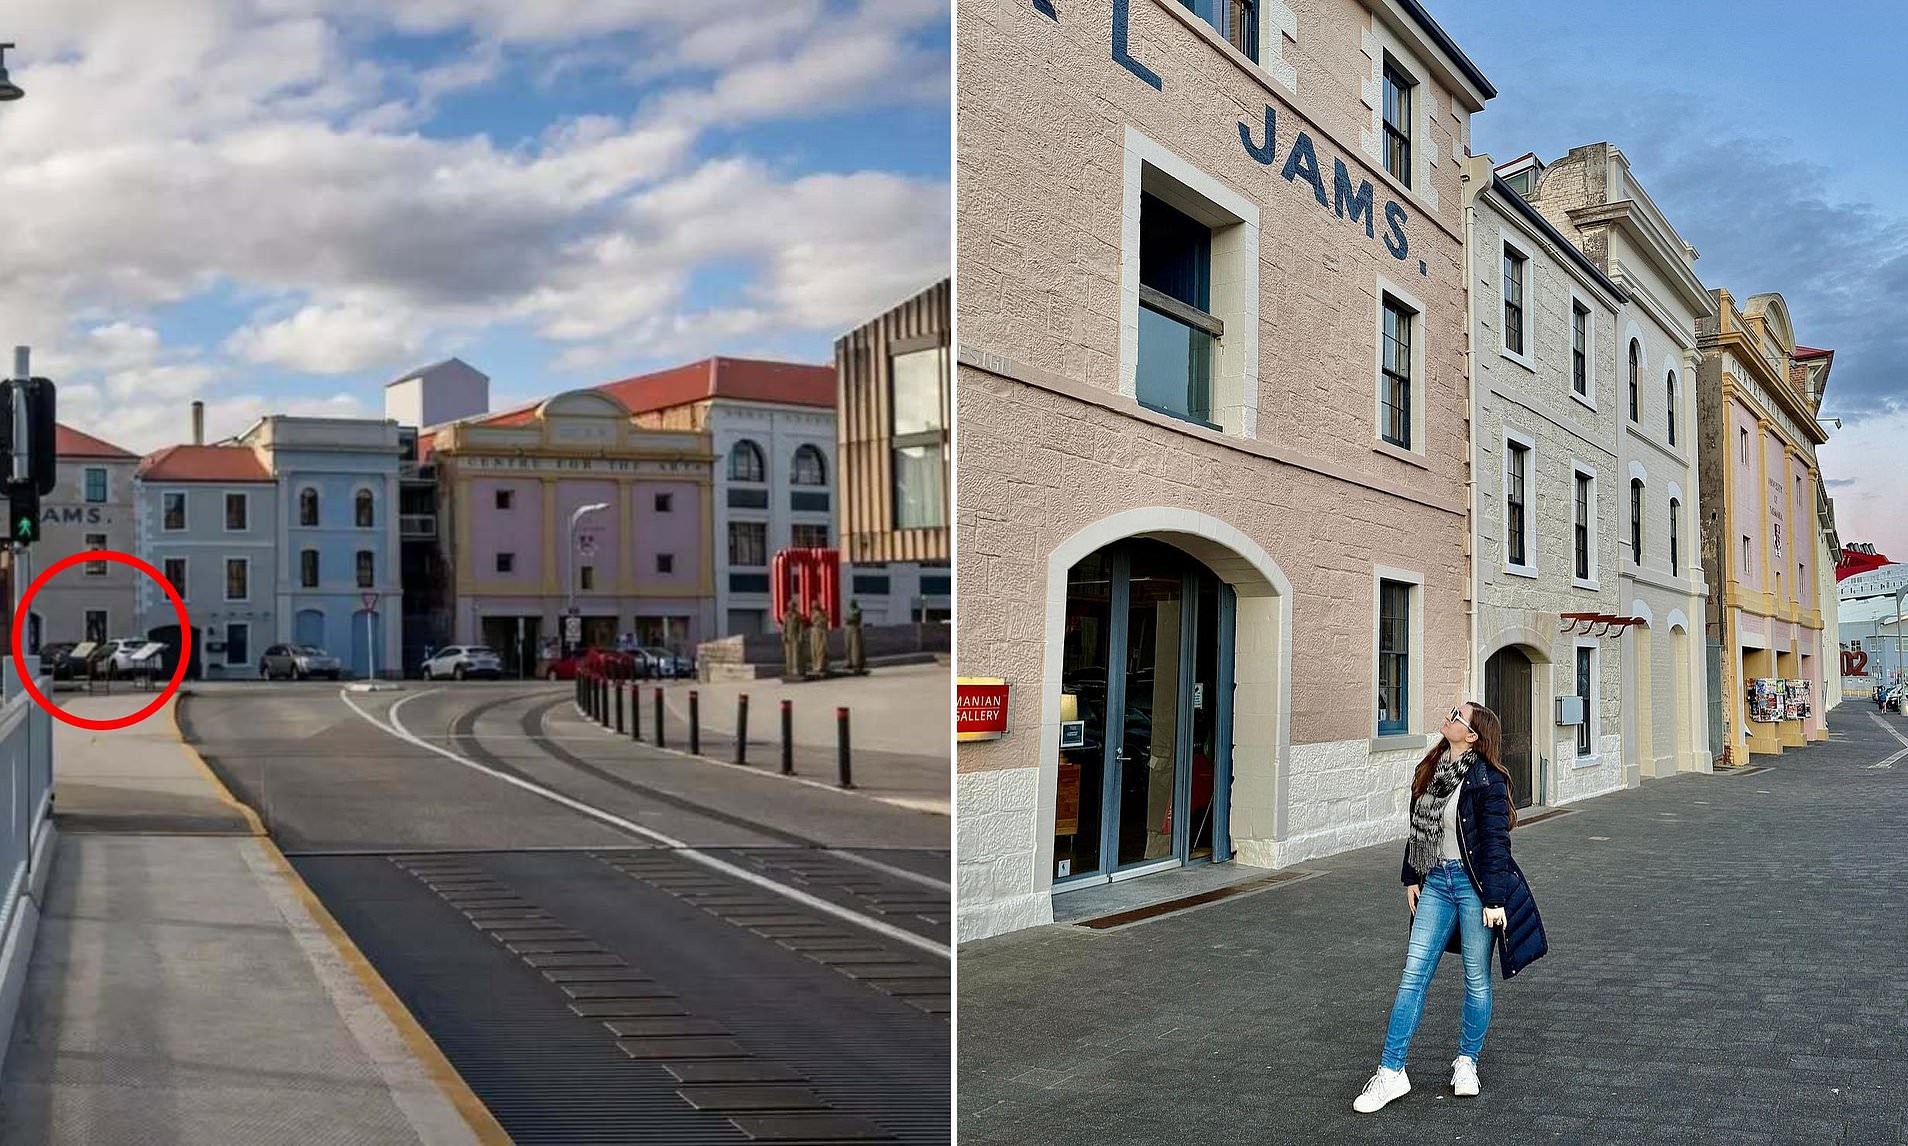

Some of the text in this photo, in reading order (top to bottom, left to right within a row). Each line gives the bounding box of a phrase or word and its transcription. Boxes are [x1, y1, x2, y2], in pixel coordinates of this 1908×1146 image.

[1032, 0, 1427, 277] L JAMS.
[42, 508, 112, 523] AMS.
